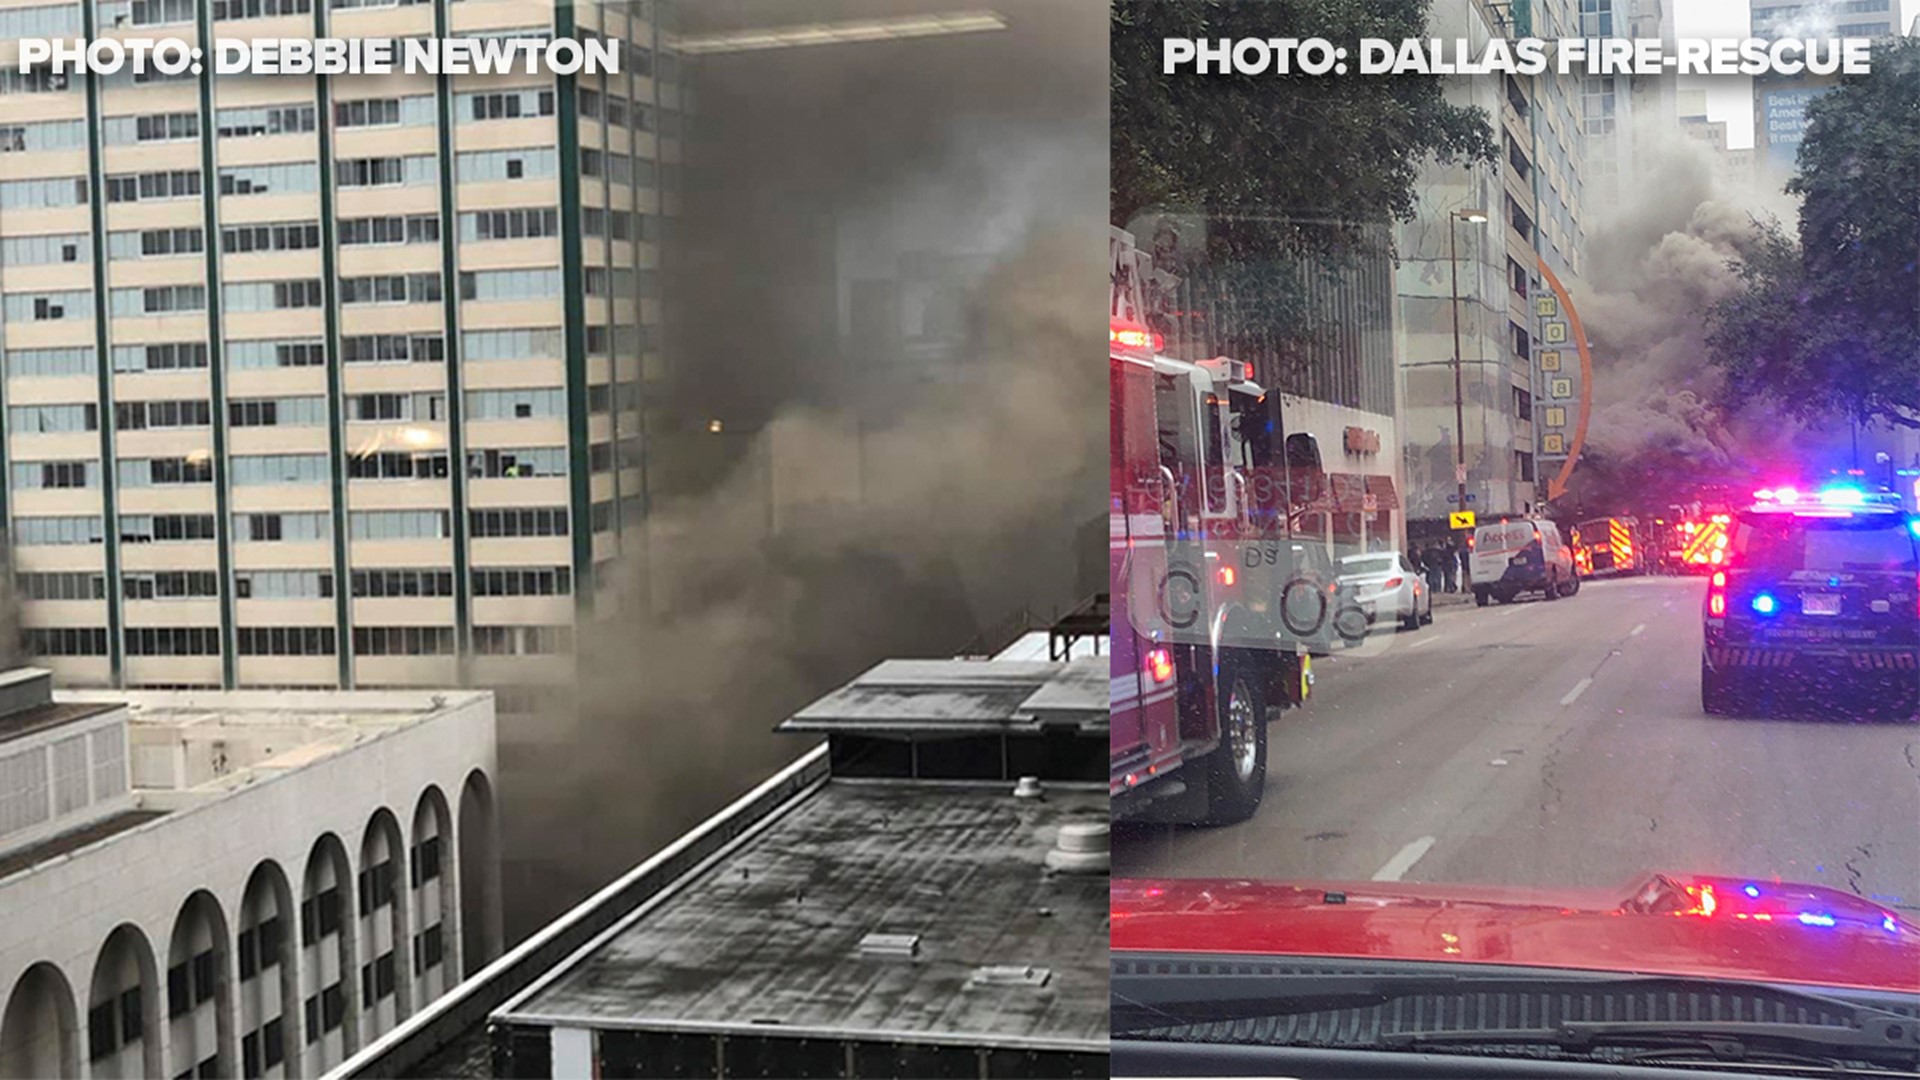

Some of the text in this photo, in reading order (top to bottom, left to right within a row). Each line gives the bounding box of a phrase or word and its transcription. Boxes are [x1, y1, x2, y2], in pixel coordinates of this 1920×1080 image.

[1768, 95, 1796, 106] Best
[1769, 108, 1805, 118] Amer
[1770, 120, 1797, 131] Best
[1538, 300, 1570, 451] mosaic
[1483, 529, 1525, 545] Access
